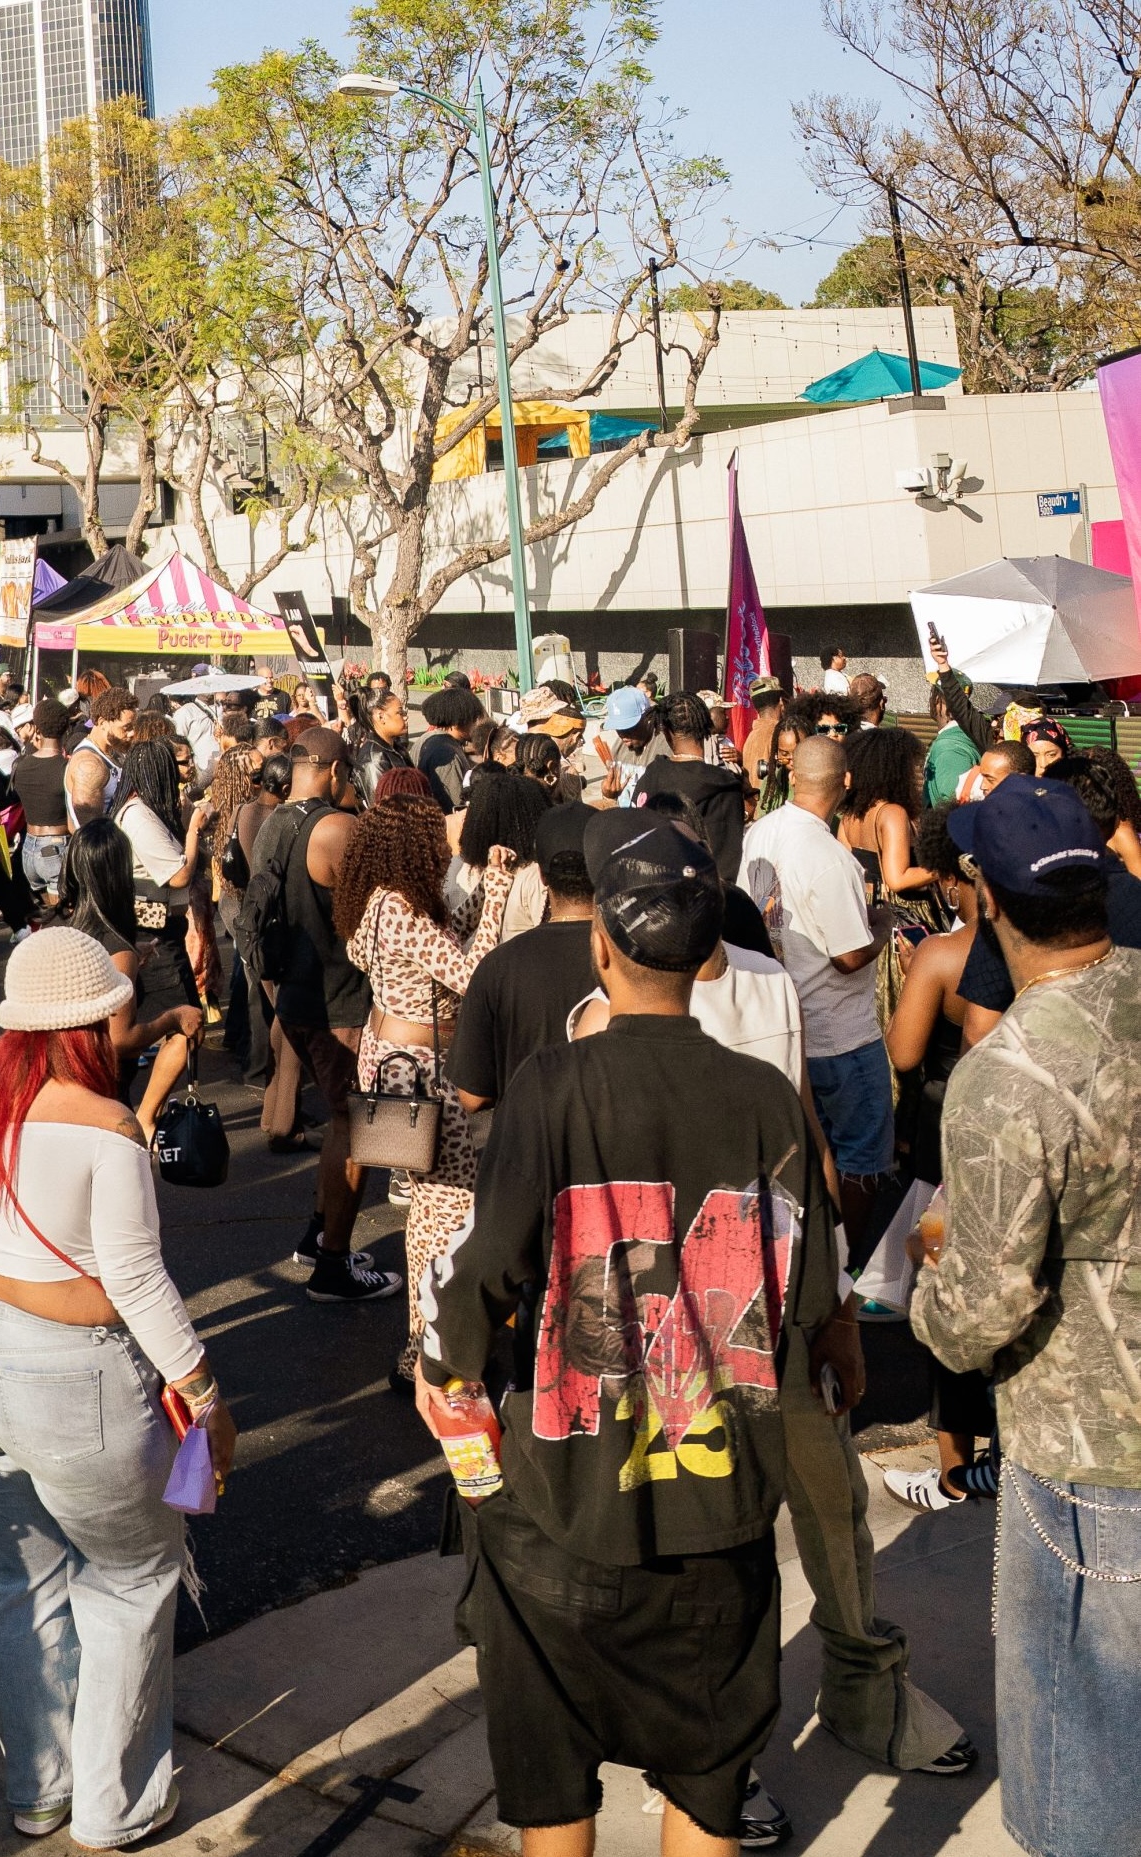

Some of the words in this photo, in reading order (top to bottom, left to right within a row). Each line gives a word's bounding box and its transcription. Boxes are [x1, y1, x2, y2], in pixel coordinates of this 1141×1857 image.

[1038, 494, 1067, 509] Beaudry
[118, 611, 275, 626] LEMONADE
[220, 630, 243, 653] Up
